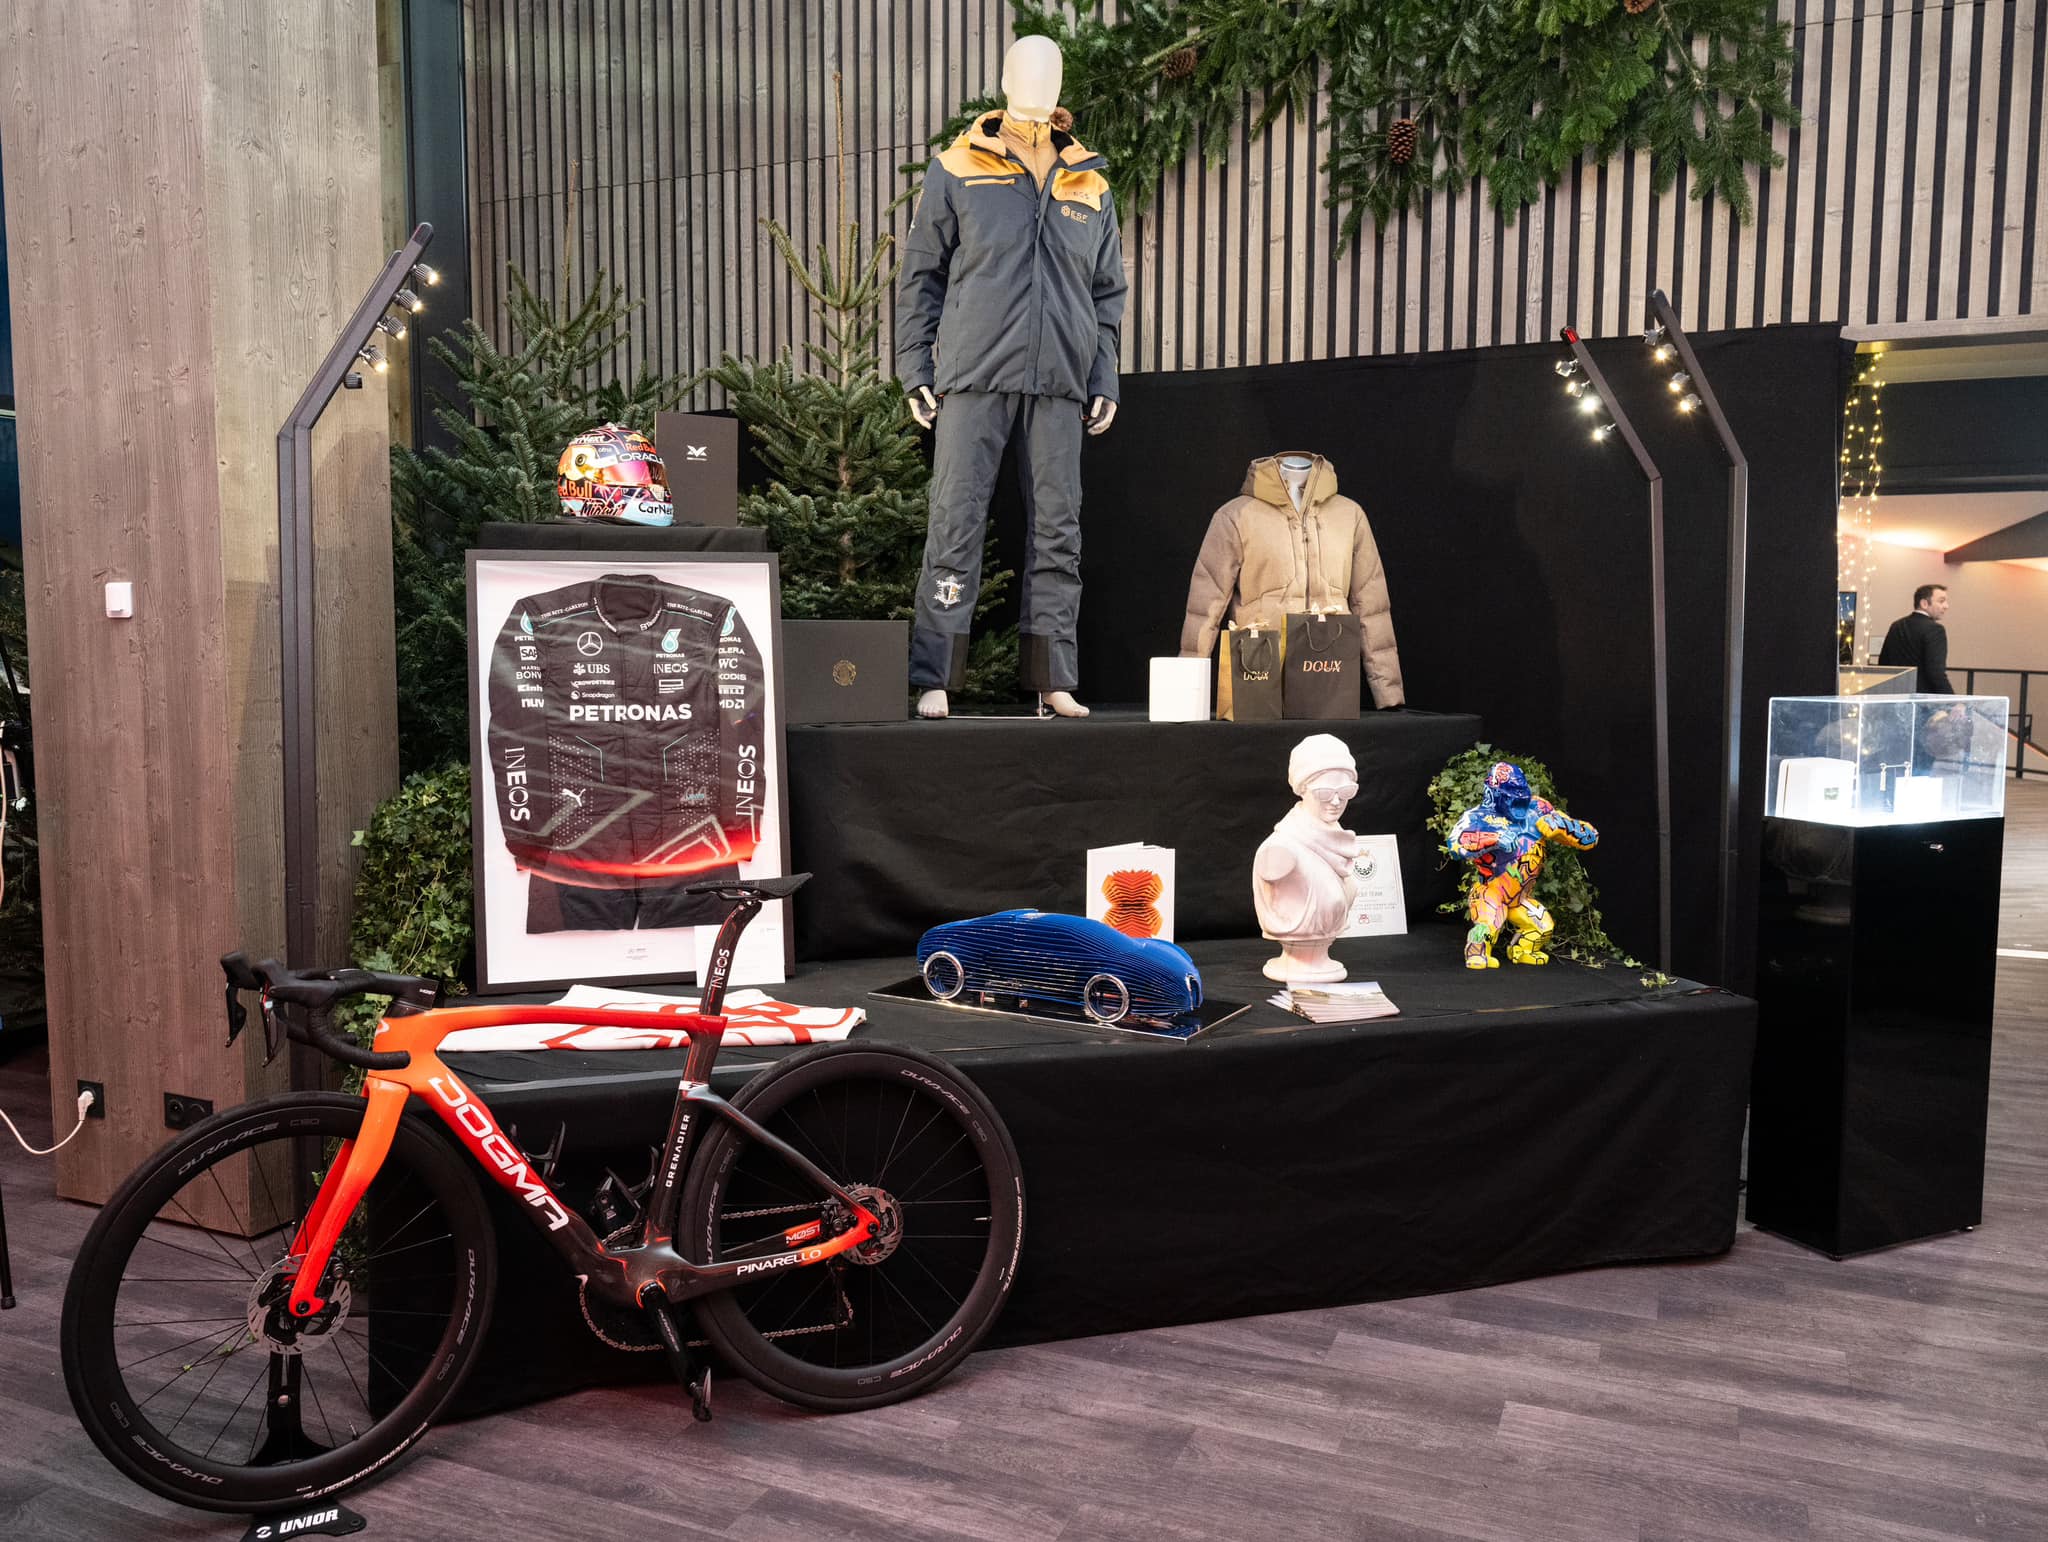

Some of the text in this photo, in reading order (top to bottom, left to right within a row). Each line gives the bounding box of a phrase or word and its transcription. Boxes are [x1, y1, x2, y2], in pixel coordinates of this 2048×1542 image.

[569, 480, 593, 499] Bull
[587, 663, 611, 674] UBS
[653, 662, 689, 674] INEOS
[1302, 660, 1342, 673] DOUX
[581, 691, 616, 699] Snapdragon
[569, 703, 693, 722] PETRONAS
[504, 745, 531, 822] INEOS
[735, 743, 757, 817] INEOS
[711, 948, 730, 989] INEOS
[178, 1121, 281, 1176] DURA-ACE
[427, 1073, 570, 1232] DOGMA
[664, 1114, 691, 1188] GRENADIER
[736, 1248, 823, 1276] PINARELLO
[279, 1508, 339, 1534] UNIOR
